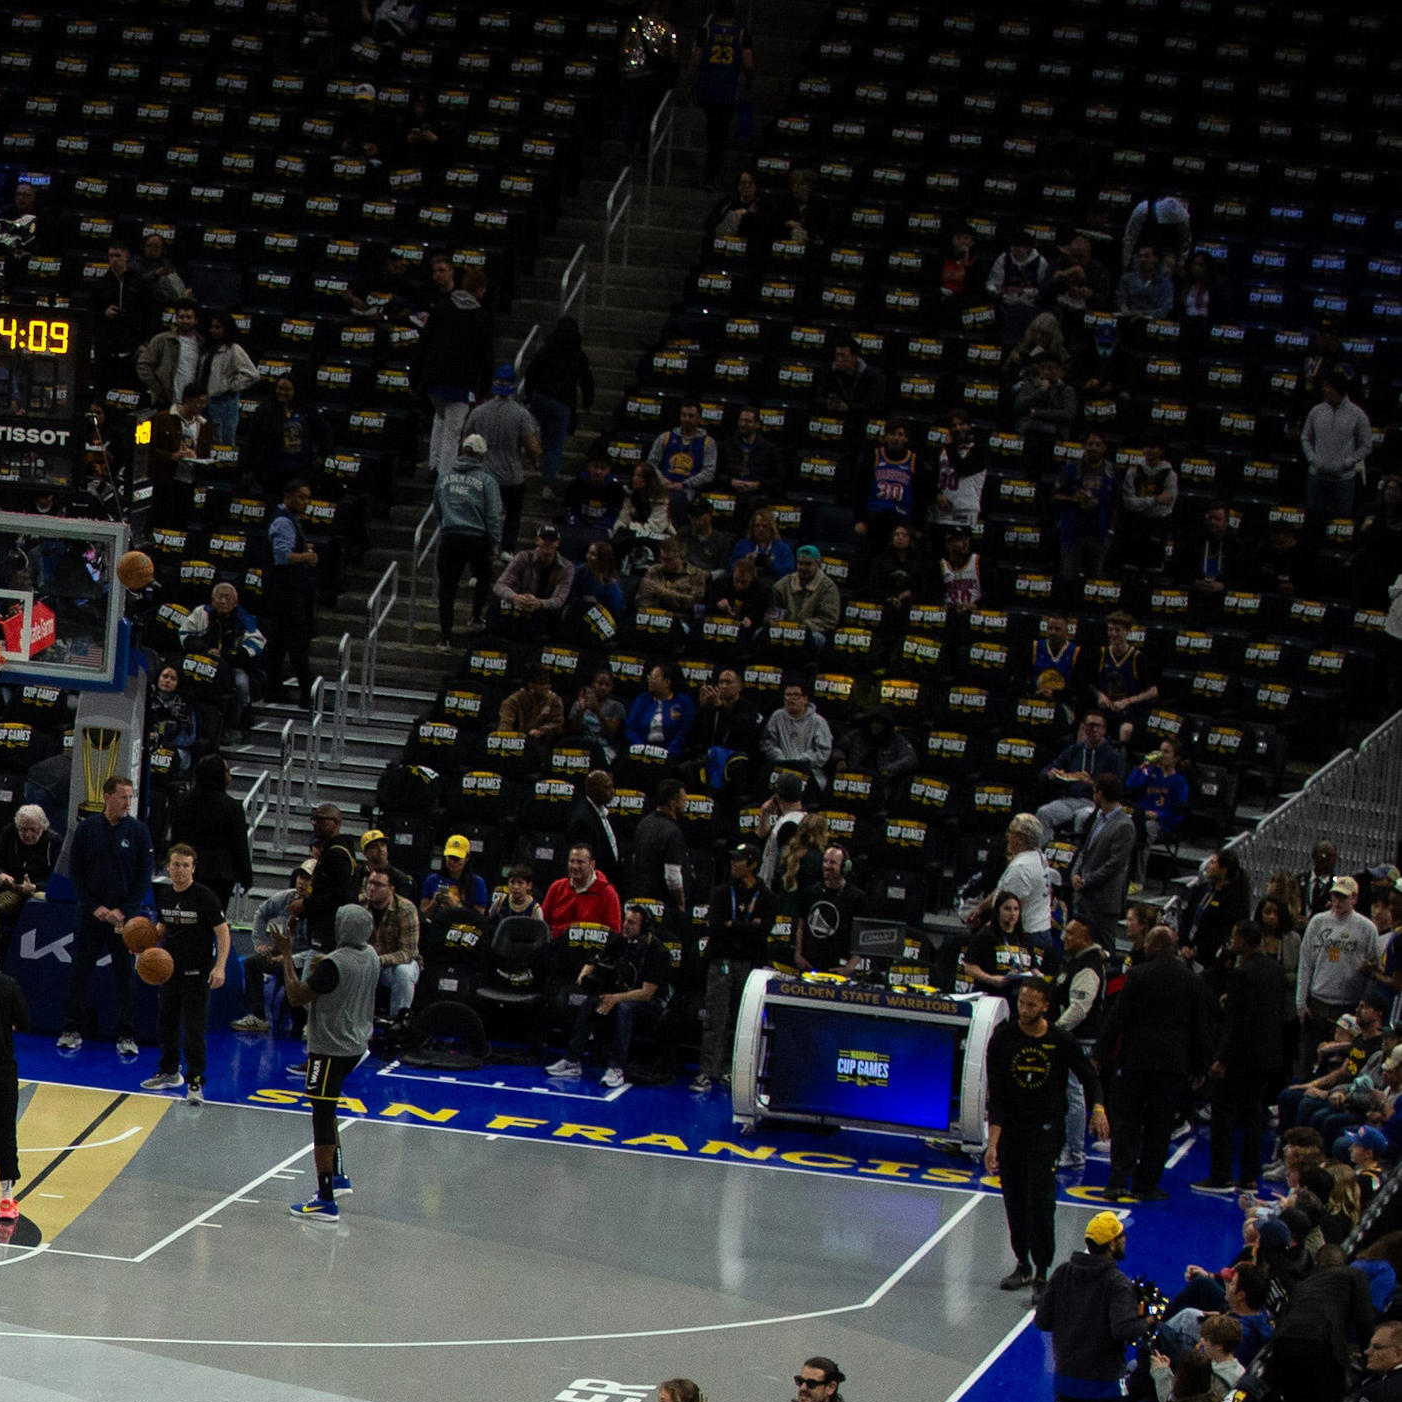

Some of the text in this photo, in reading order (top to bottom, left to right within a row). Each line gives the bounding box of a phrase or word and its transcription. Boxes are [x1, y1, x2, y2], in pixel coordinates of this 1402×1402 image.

[708, 45, 735, 65] 23
[780, 984, 959, 1014] GOLDEN STATE WARRIORS
[837, 1058, 890, 1080] CUP GAMES
